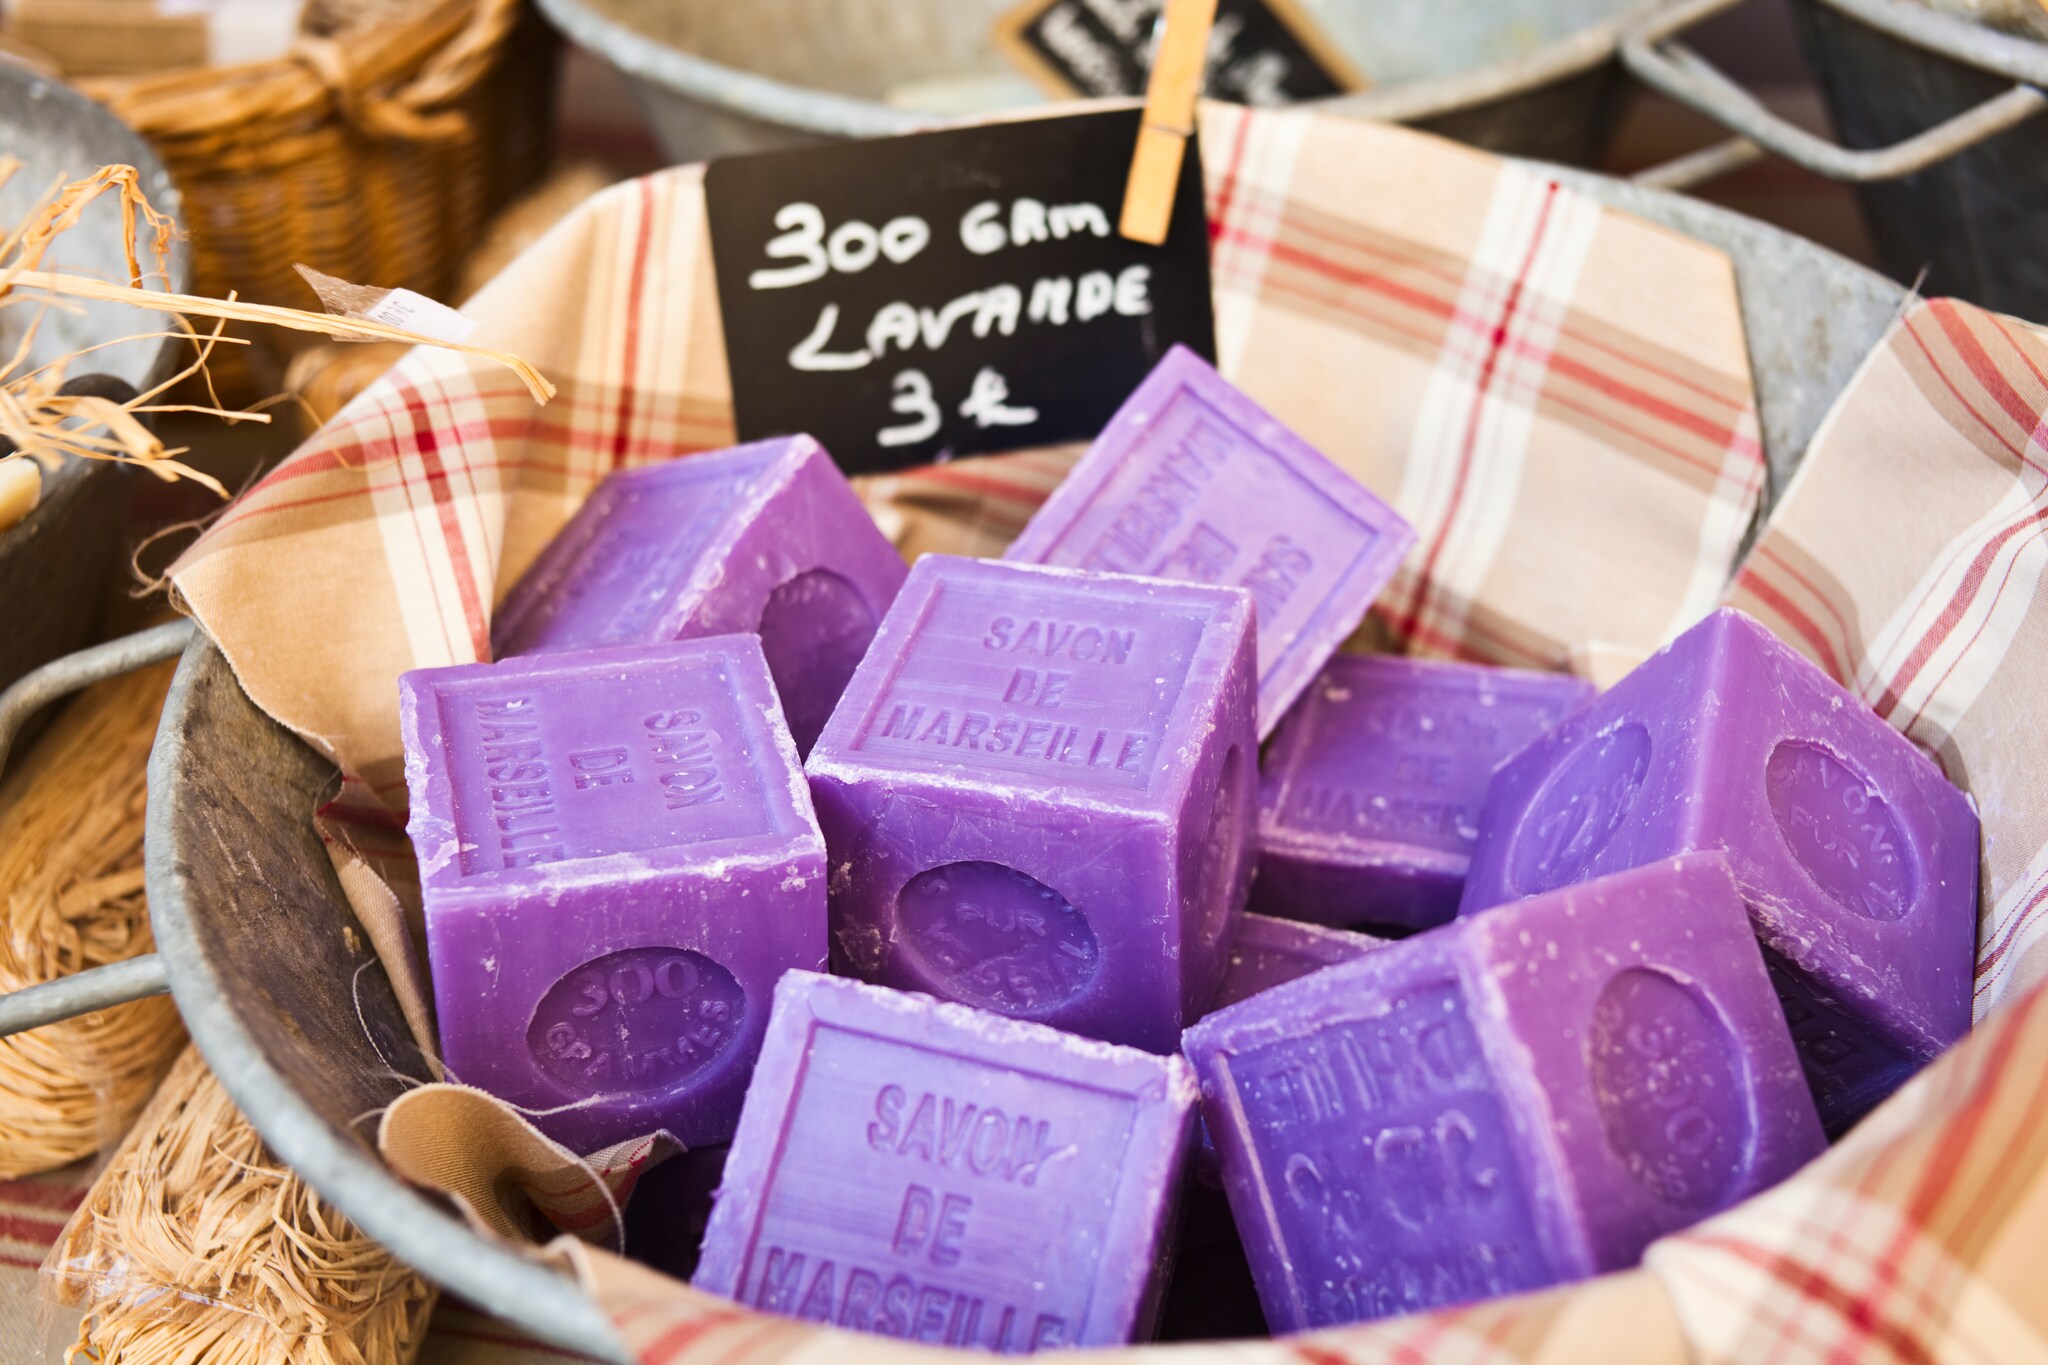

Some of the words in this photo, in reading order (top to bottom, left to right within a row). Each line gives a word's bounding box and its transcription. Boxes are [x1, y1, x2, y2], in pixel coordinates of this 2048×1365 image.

[749, 202, 930, 289] 300
[877, 369, 942, 446] 3
[983, 616, 1136, 665] SAVON
[1002, 667, 1071, 708] DE
[569, 745, 636, 791] DE
[643, 707, 725, 811] SAVON
[880, 704, 1152, 772] MARSEILLE
[475, 696, 567, 869] MARSEILLE
[866, 1082, 1052, 1186] SAVON
[891, 1183, 973, 1268] DE
